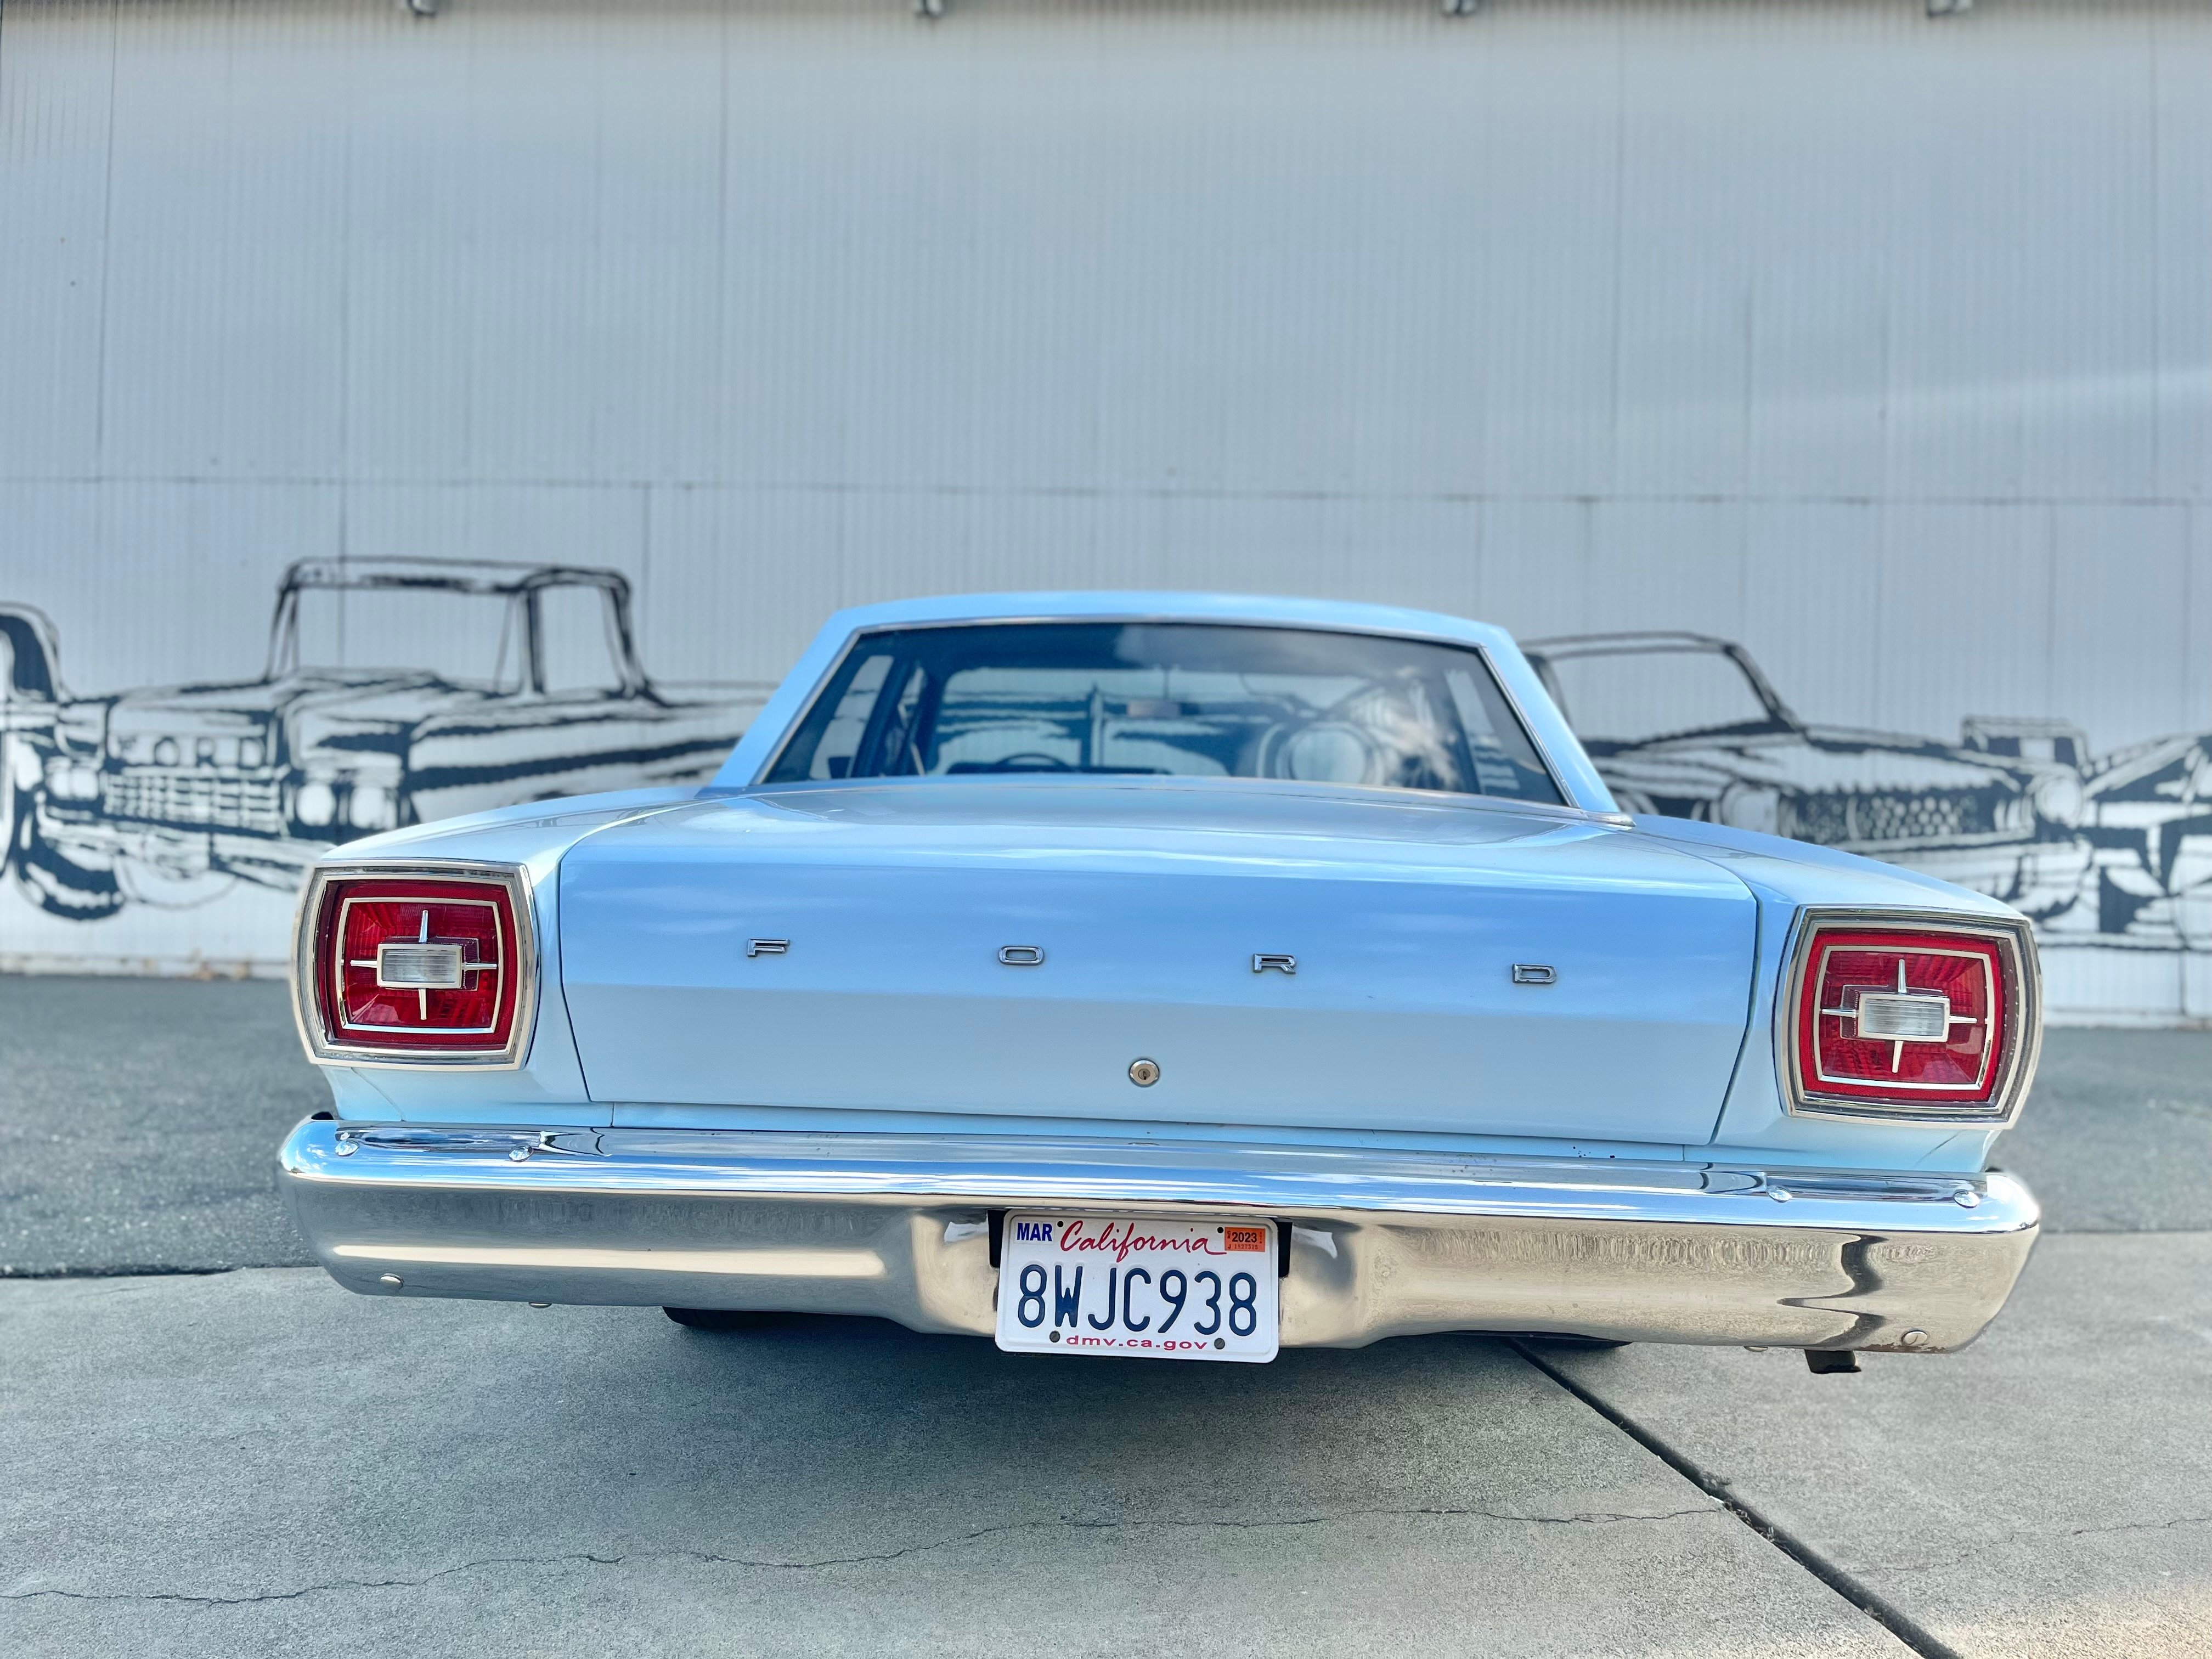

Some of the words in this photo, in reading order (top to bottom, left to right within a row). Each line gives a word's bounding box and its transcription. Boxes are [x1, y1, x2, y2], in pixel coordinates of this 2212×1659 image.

[1017, 1222, 1052, 1242] MAR
[1060, 1220, 1227, 1263] California
[1232, 1232, 1257, 1243] 2023
[1018, 1265, 1256, 1336] 8WJC938
[1066, 1335, 1207, 1350] dmv.ca.gov
